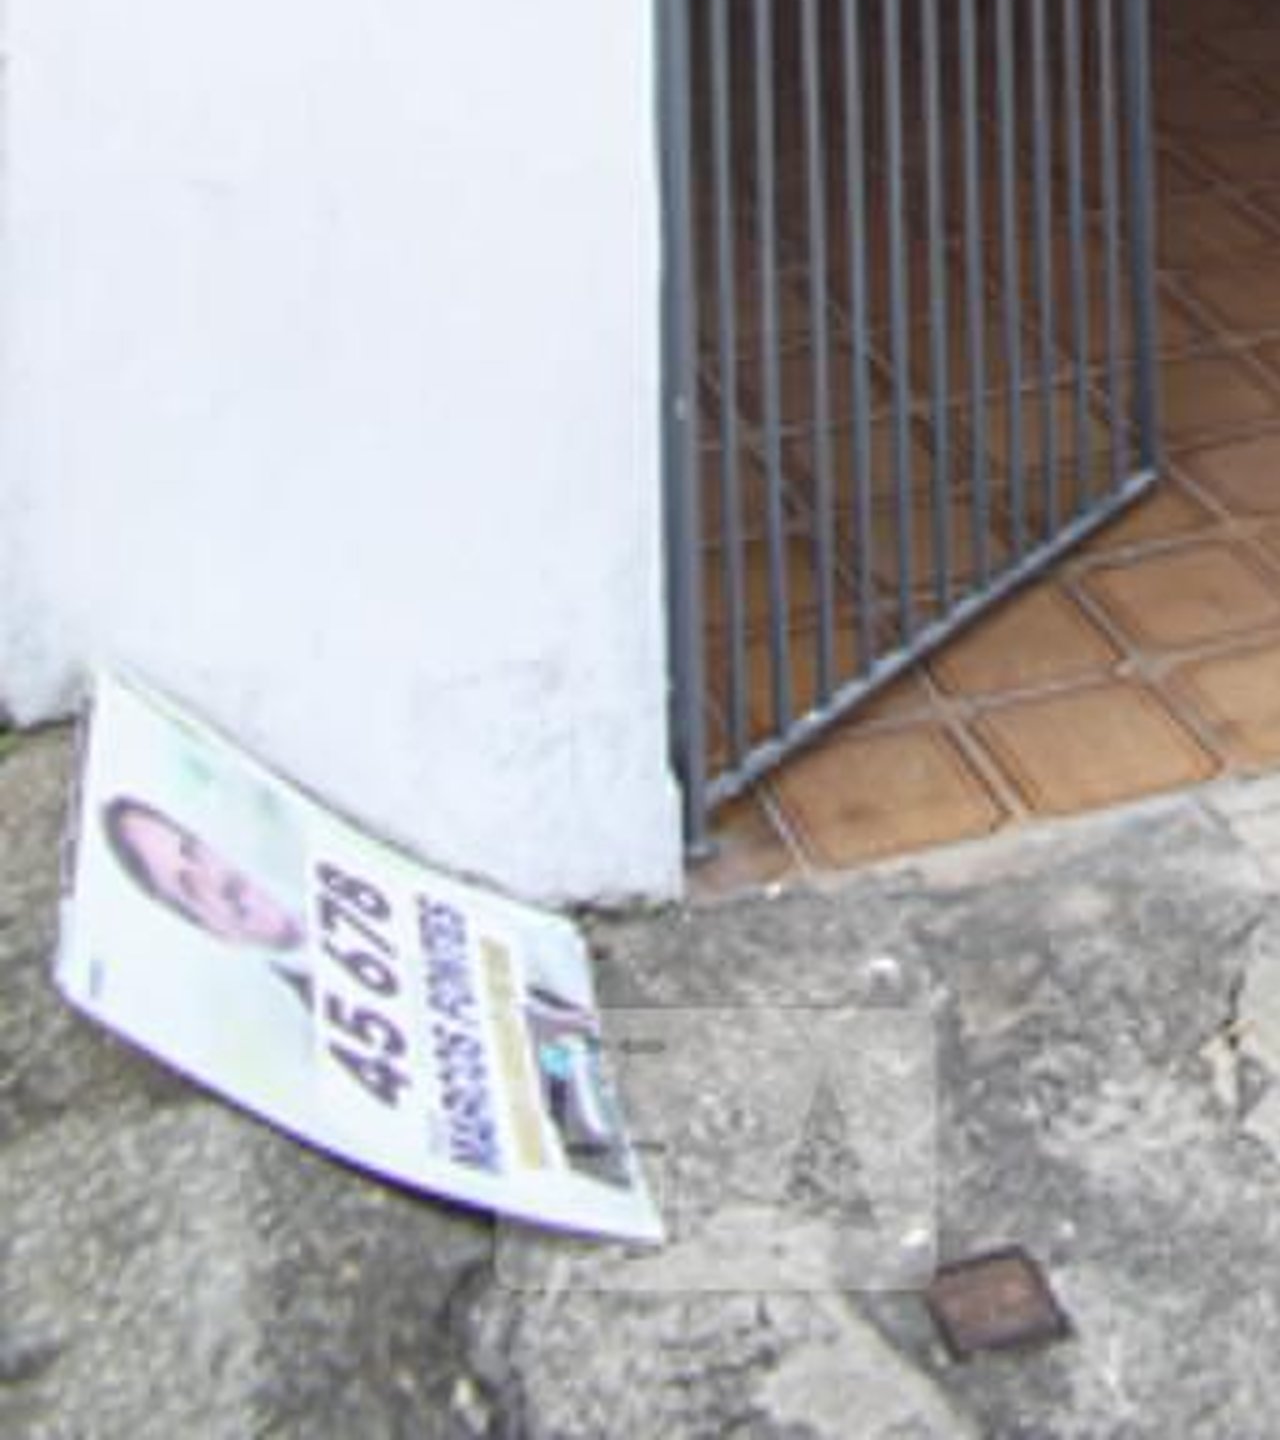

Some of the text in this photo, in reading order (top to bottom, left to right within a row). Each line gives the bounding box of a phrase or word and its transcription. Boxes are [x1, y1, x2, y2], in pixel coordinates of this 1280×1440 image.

[314, 860, 412, 1110] 45 678
[431, 1023, 503, 1176] MARCOS
